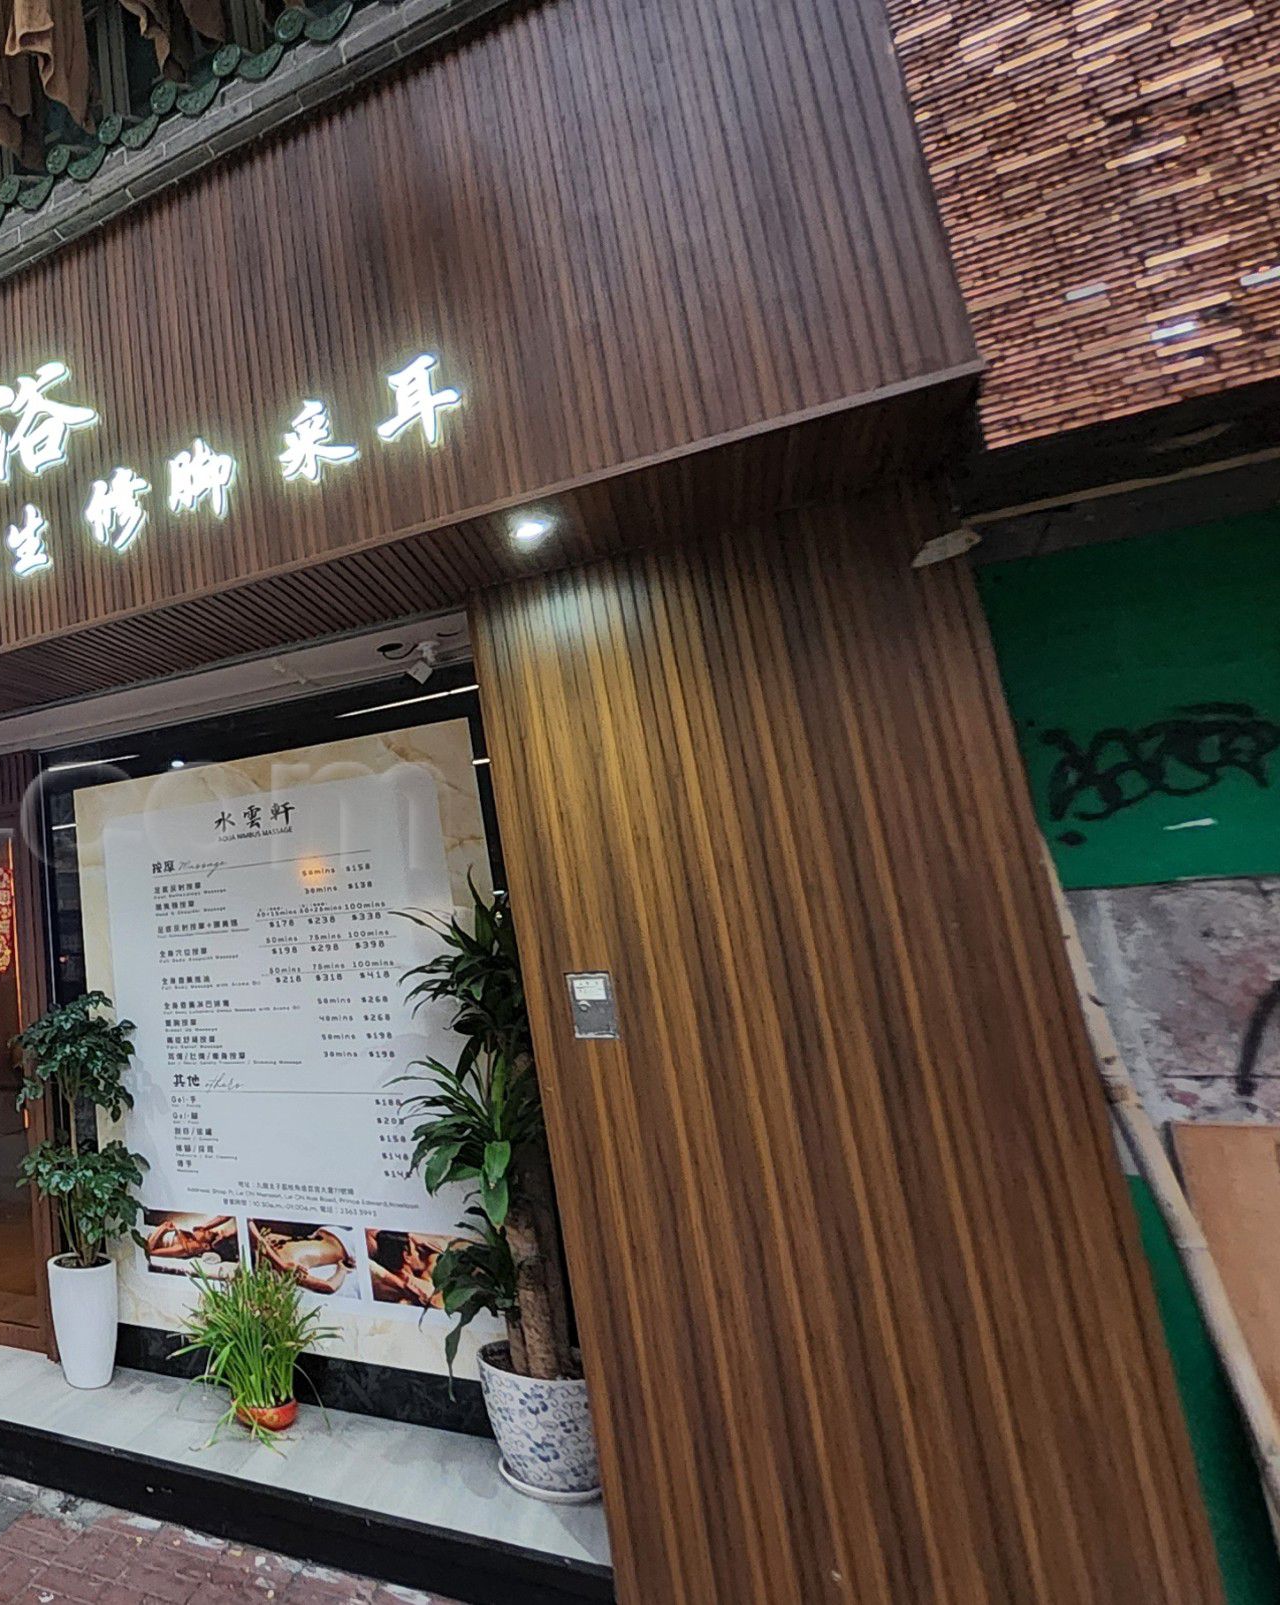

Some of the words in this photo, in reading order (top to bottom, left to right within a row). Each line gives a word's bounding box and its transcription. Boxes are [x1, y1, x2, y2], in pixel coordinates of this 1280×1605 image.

[214, 801, 295, 833] 水雲軒
[262, 826, 293, 836] MASSAGE
[152, 860, 175, 874] 按摩
[308, 916, 336, 924] $238
[352, 912, 382, 921] $338
[272, 945, 298, 955] $198
[311, 943, 339, 952] $298
[355, 940, 385, 949] $398
[352, 960, 395, 968] 100mins
[315, 973, 343, 982] $318
[360, 970, 390, 979] $418
[173, 1074, 200, 1088] 其他
